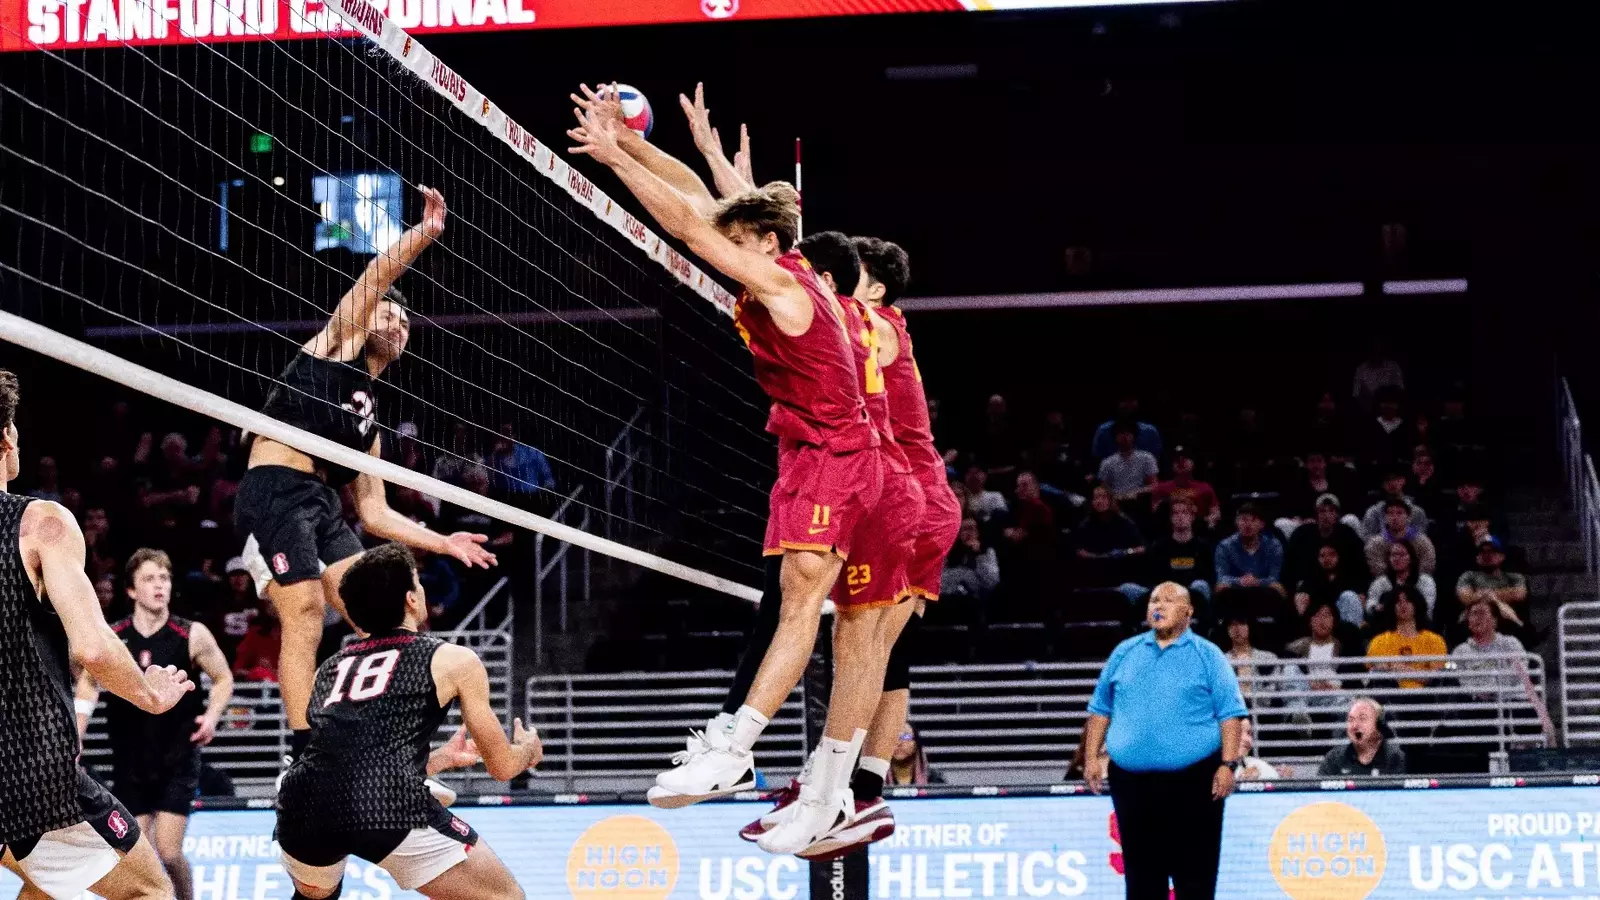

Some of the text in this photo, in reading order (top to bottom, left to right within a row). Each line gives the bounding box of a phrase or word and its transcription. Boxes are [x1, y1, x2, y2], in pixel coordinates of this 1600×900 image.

[27, 0, 536, 44] STANFORD CDINAL
[811, 503, 830, 526] 11
[846, 563, 872, 586] 23
[322, 648, 402, 709] 18
[878, 822, 1009, 848] ARTNER OF
[1487, 812, 1573, 837] PROUD
[1287, 831, 1367, 854] HIGH
[585, 844, 662, 866] HIGH
[1281, 855, 1376, 878] NOON
[1408, 842, 1600, 891] USC AT
[576, 868, 669, 889] NOON
[699, 850, 1088, 900] USC HLETICS
